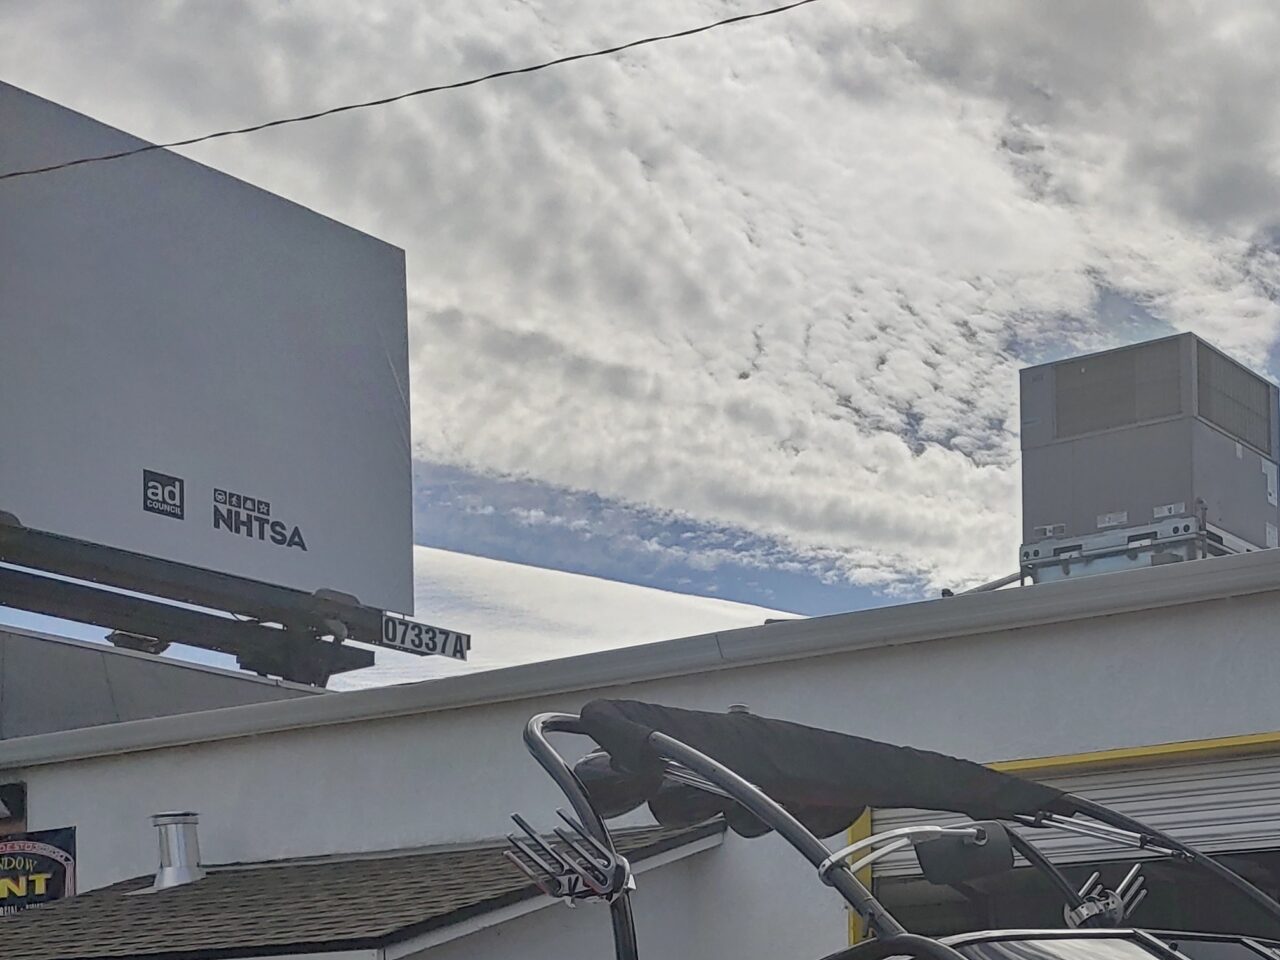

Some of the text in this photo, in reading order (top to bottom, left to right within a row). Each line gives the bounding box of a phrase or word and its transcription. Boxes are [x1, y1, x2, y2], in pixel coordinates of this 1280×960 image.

[146, 479, 181, 505] ad
[146, 499, 182, 515] COUNCIL
[213, 504, 308, 551] NHTSA
[383, 620, 467, 660] 07337A
